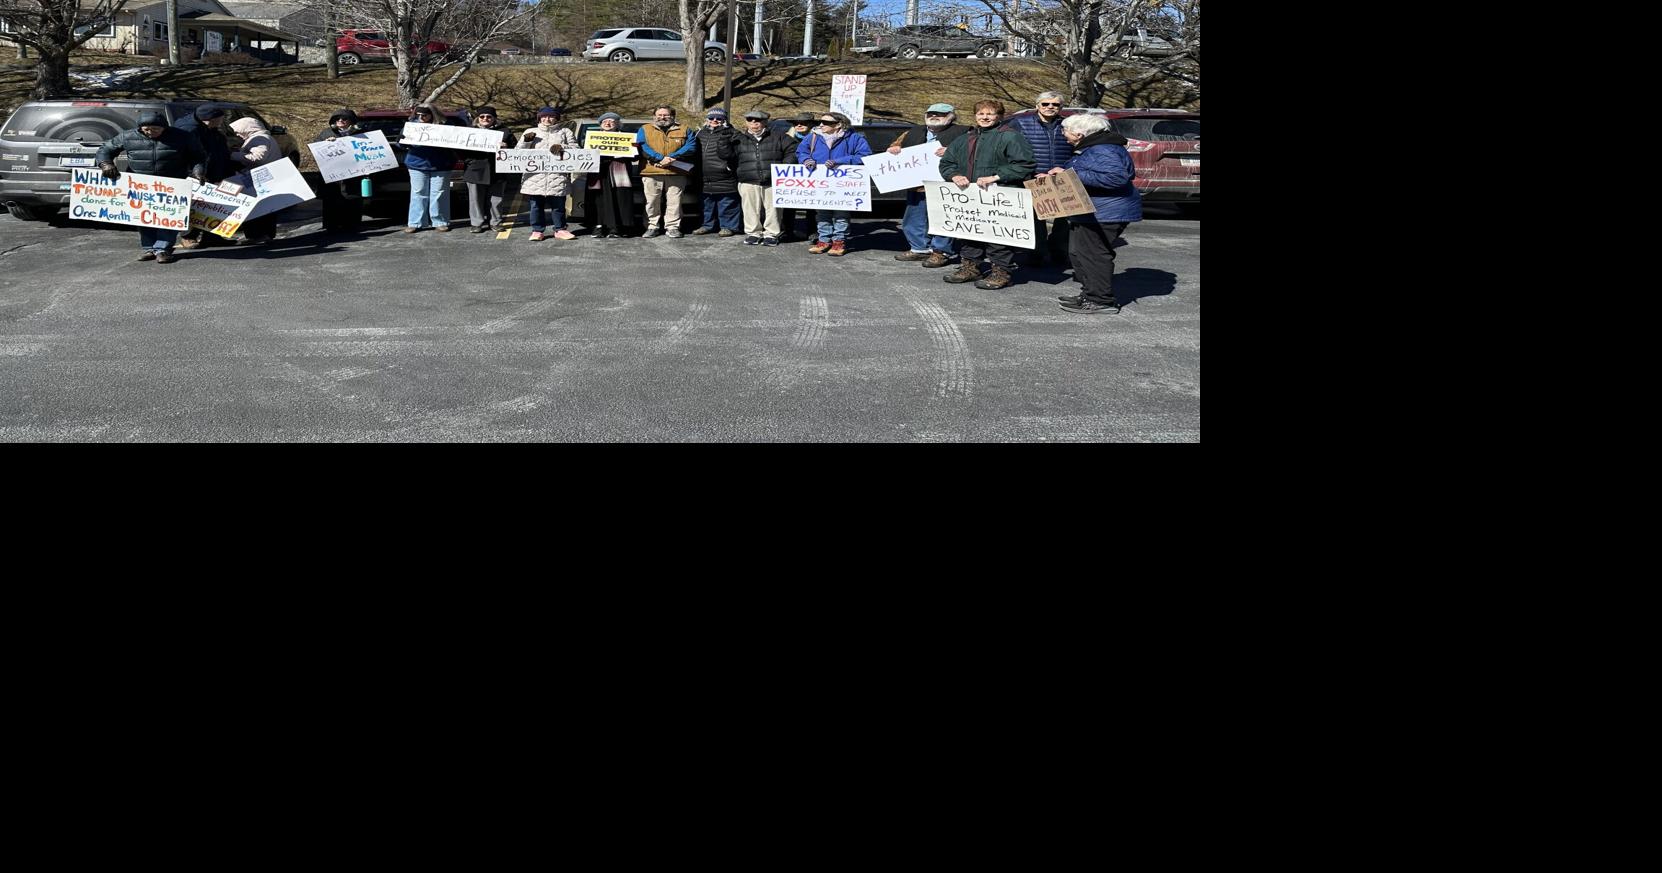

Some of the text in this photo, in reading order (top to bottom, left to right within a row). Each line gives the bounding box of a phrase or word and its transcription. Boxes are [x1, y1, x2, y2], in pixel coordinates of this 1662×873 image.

[834, 76, 866, 85] STAND
[589, 144, 630, 152] VOTES
[496, 150, 593, 162] Democracy Dies
[510, 163, 521, 171] in
[525, 161, 575, 172] Silence
[775, 165, 863, 179] WHY DOES
[128, 175, 149, 191] has
[151, 181, 175, 193] the
[775, 178, 830, 188] FOXX'S
[201, 184, 252, 207] Democrats
[775, 188, 817, 197] REFUSE
[81, 195, 106, 205] done
[110, 197, 125, 207] for
[130, 199, 142, 209] U
[156, 193, 188, 206] TEAM
[73, 205, 97, 218] One
[99, 207, 130, 221] Month
[943, 204, 1027, 220] Protect Medicaid
[955, 214, 1000, 225] Medicare
[942, 220, 1031, 240] SAVE LIVES
